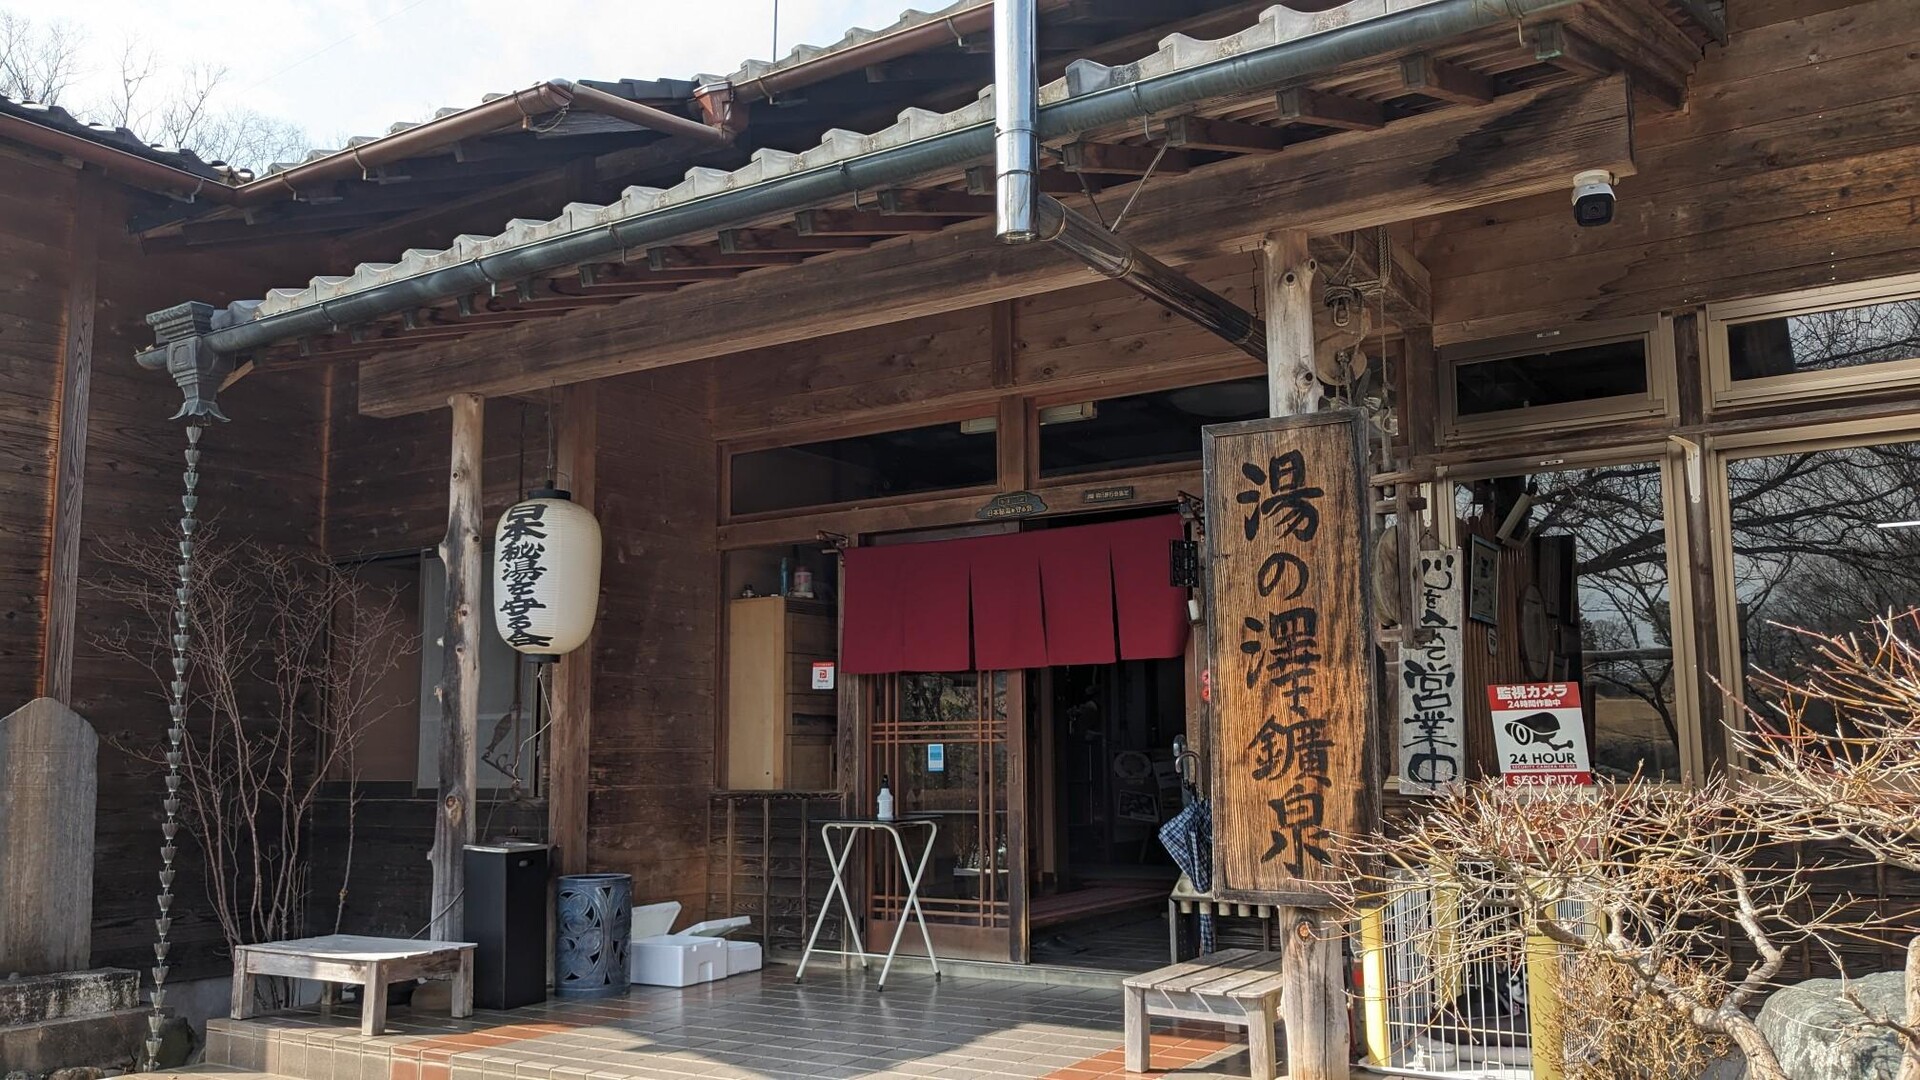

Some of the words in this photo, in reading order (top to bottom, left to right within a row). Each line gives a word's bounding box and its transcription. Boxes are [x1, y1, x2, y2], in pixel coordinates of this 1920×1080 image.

[500, 503, 553, 647] 日本秘湯を守る会
[1236, 449, 1334, 879] 湯の澤鑛泉
[1496, 684, 1568, 700] 監視カメラ
[1507, 699, 1561, 708] 24時間作動中
[1510, 753, 1528, 764] 24
[1532, 753, 1576, 764] HOUR
[1513, 775, 1577, 785] SECURITY
